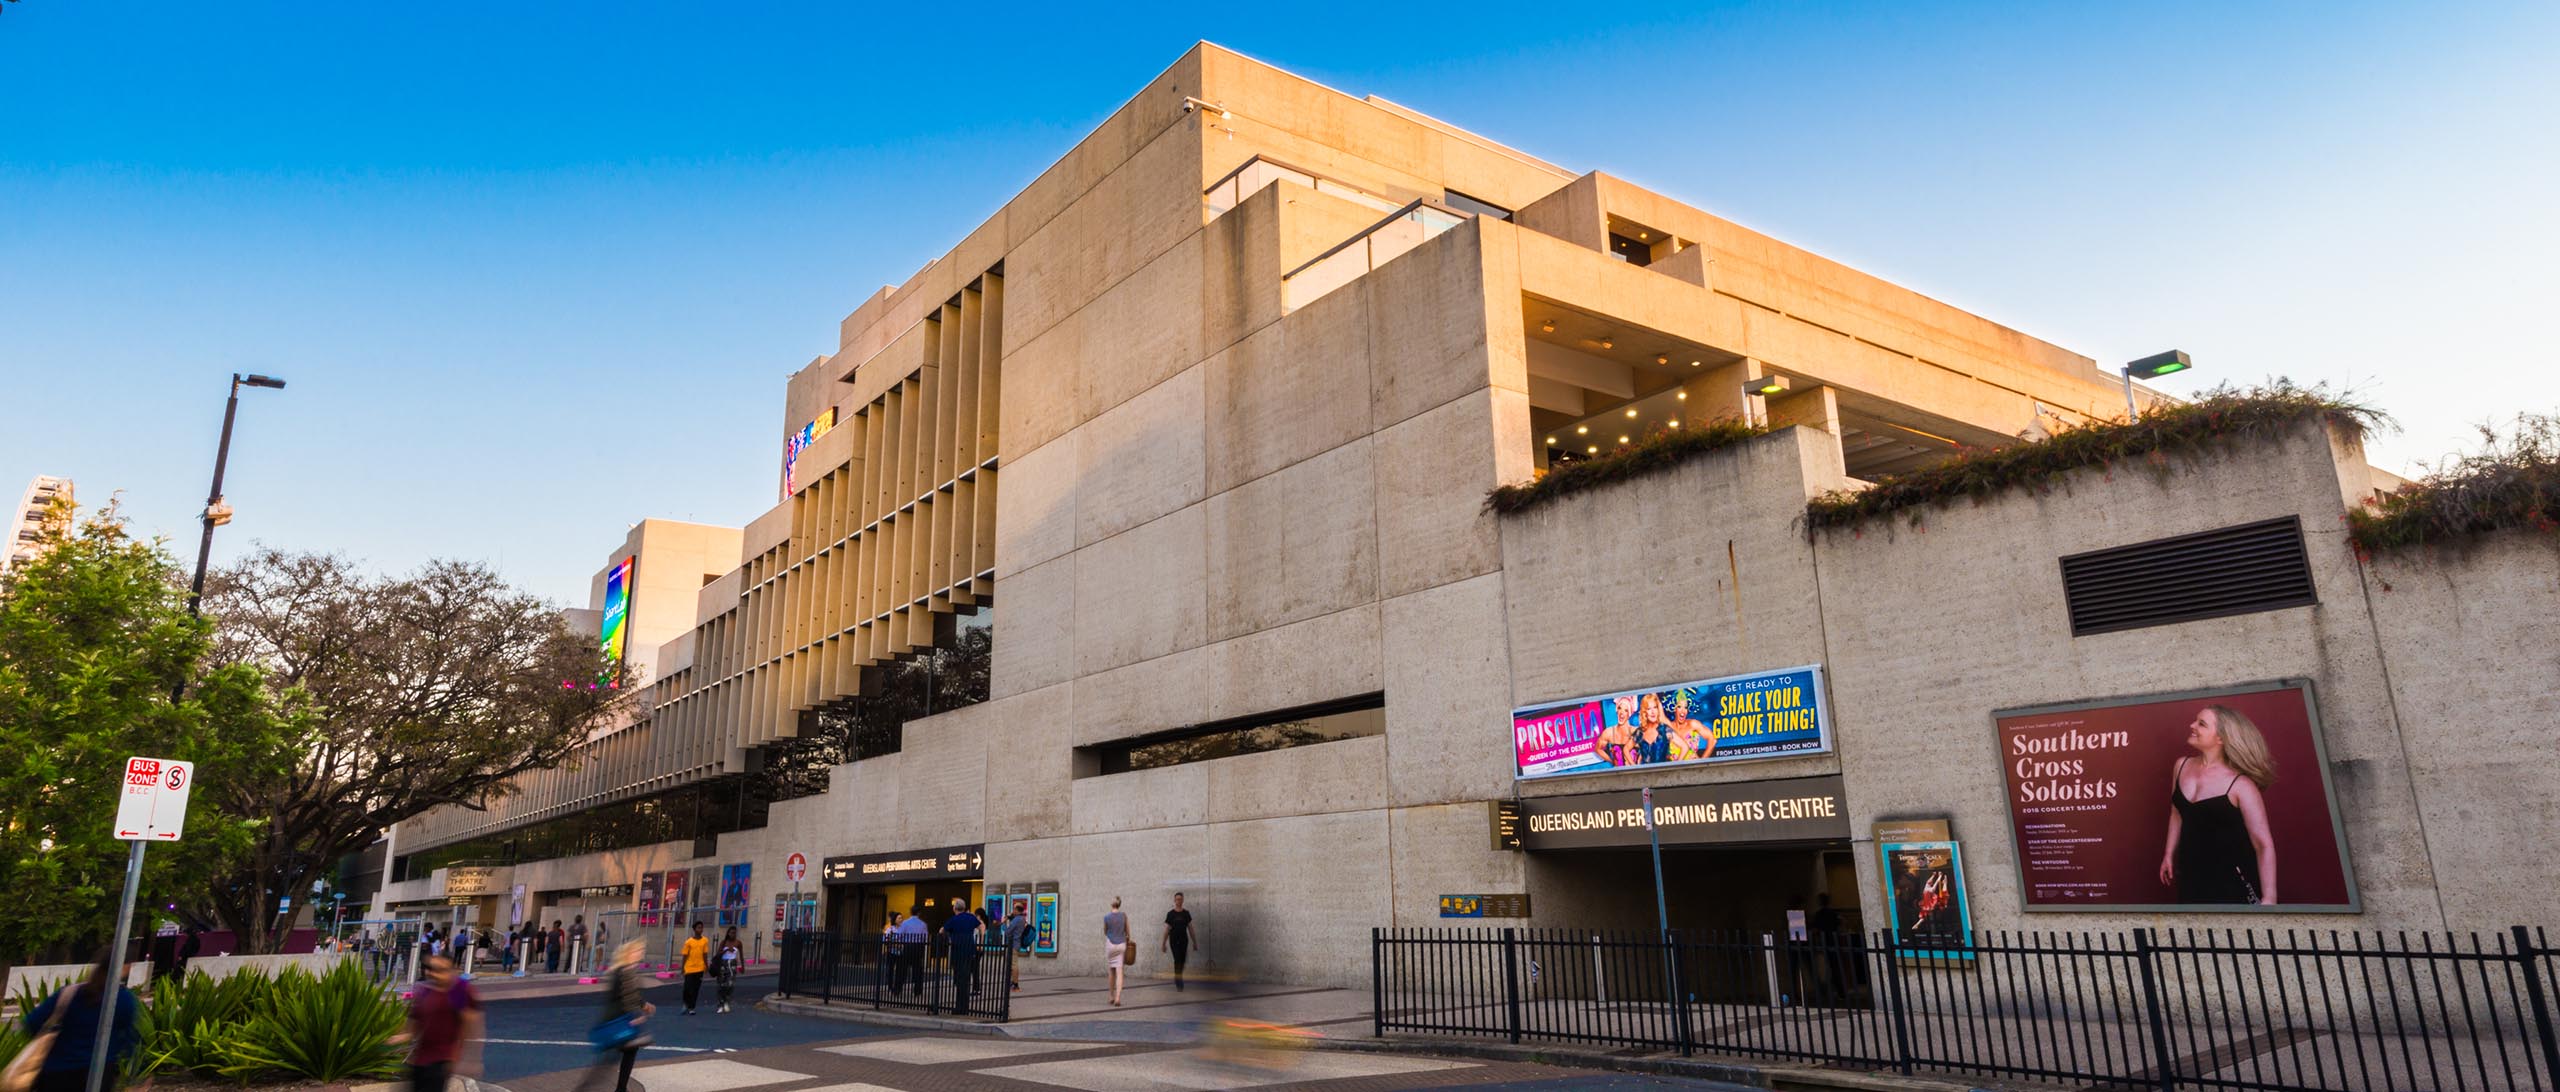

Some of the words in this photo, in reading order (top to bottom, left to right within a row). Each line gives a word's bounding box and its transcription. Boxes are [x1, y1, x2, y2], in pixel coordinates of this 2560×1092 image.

[1725, 683, 1742, 692] GET
[1745, 679, 1775, 689] READY
[1778, 676, 1792, 685] TO
[1720, 691, 1761, 716] SHAKE
[1765, 686, 1801, 711] YOUR
[1517, 709, 1600, 754] PRISCILLA
[1713, 714, 1764, 739] GROOVE
[1767, 707, 1815, 734] THING!
[1558, 747, 1570, 755] THE
[1742, 745, 1778, 755] SEPTEMBER
[2013, 729, 2129, 755] Southern
[133, 761, 155, 772] BUS
[2016, 757, 2084, 778] Cross
[127, 773, 158, 785] ZONE
[2020, 778, 2117, 803] Soloists
[1529, 810, 1614, 833] QUEENSLAND
[1617, 803, 1718, 828] PERORMING
[1721, 801, 1765, 822] ARTS
[1768, 796, 1836, 820] CENTRE
[2041, 805, 2075, 813] CONCERT
[885, 860, 910, 872] PERFORMING
[910, 859, 921, 870] ARTS
